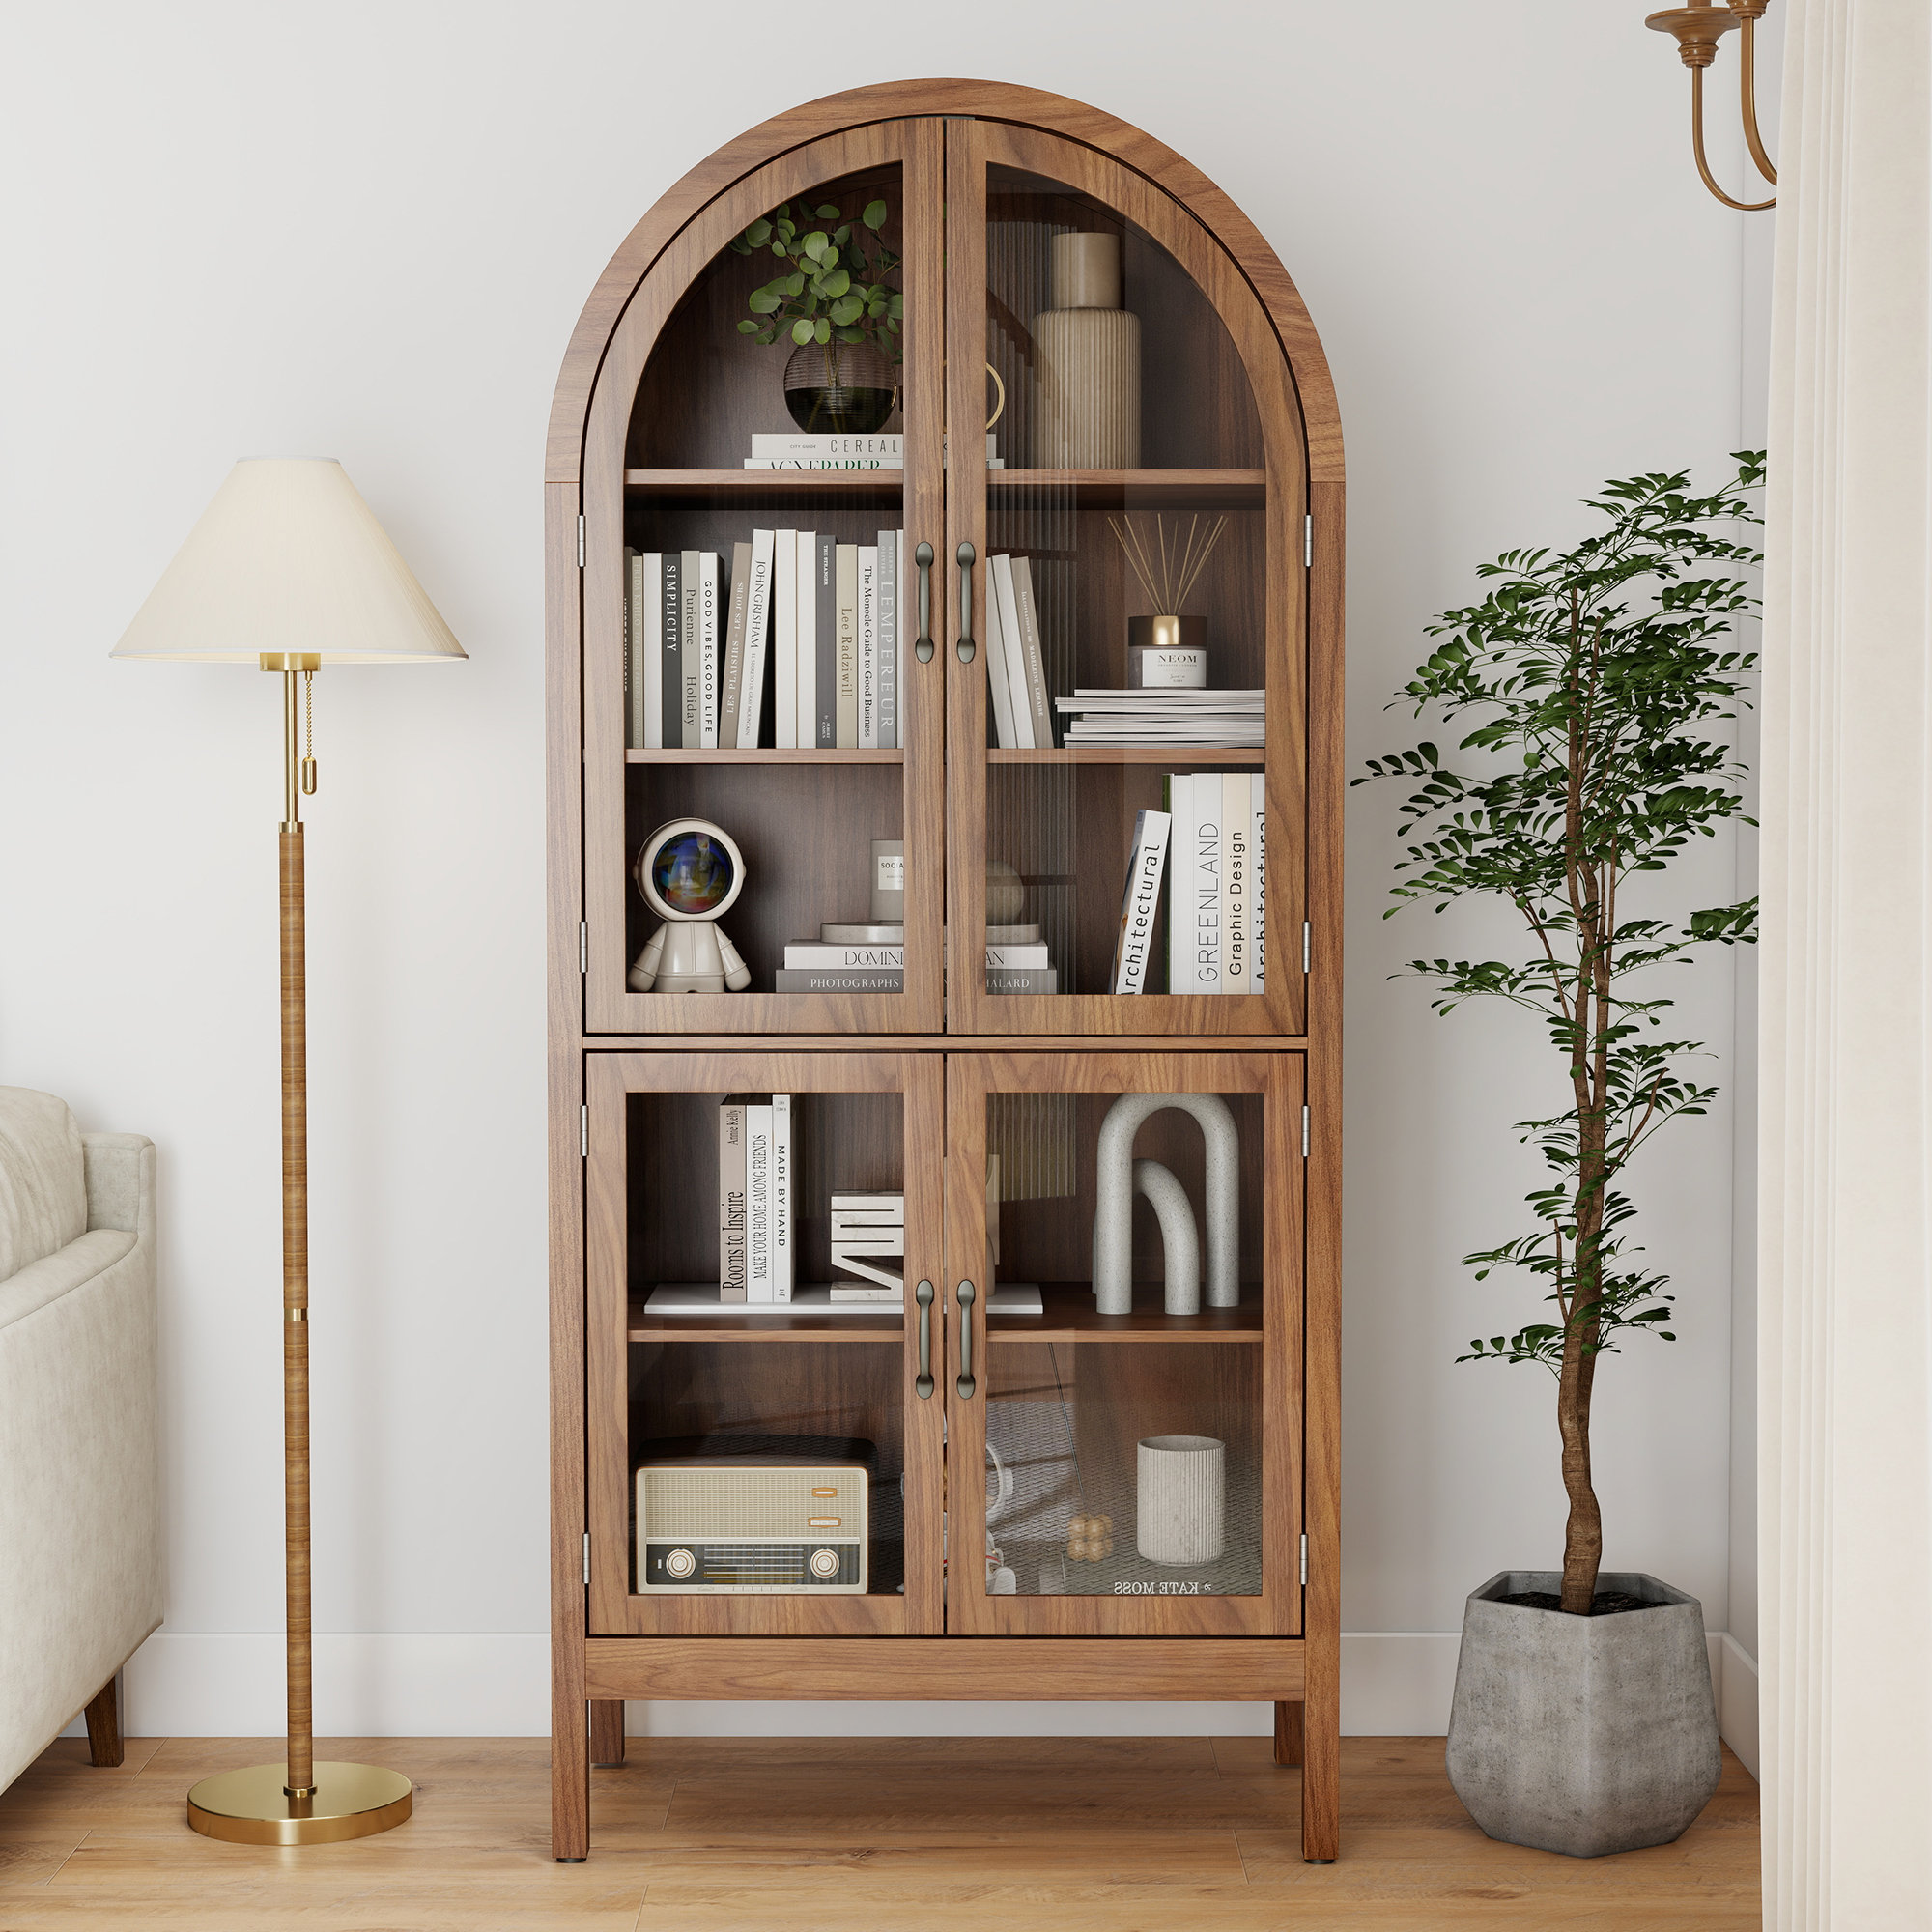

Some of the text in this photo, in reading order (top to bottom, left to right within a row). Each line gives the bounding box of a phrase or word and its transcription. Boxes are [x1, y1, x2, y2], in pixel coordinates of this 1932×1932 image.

[830, 440, 898, 453] CEREAL
[666, 564, 677, 652] SIMPLICITY
[704, 581, 713, 617] GOOD
[734, 582, 744, 611] JOURS
[685, 589, 696, 645] Purienne
[733, 612, 742, 630] LES
[727, 640, 740, 690] PLAISIRS
[840, 608, 852, 697] Lee Radziwill
[864, 565, 872, 738] The Monocle Guide to Good Business
[880, 582, 894, 728] LEMPEREUR
[1158, 654, 1197, 663] NEOM
[704, 663, 713, 700] GOOD
[1029, 645, 1039, 684] MADELEINE
[1034, 687, 1044, 717] LEMAIRE
[685, 676, 697, 726] Holiday
[704, 706, 713, 732] LIFE
[726, 695, 735, 714] LES
[1198, 823, 1219, 982] GREENLAND
[1229, 832, 1246, 976] Graphic Design
[844, 951, 904, 966] DOMINI
[810, 978, 899, 988] PHOTOGRAPHS
[726, 1110, 742, 1146] Annie Kelly
[753, 1134, 767, 1279] MAKE YOUR HOME AMONG FRIENDS
[778, 1188, 785, 1205] BY
[721, 1191, 747, 1290] Rooms to Inspire
[778, 1209, 786, 1247] HAND
